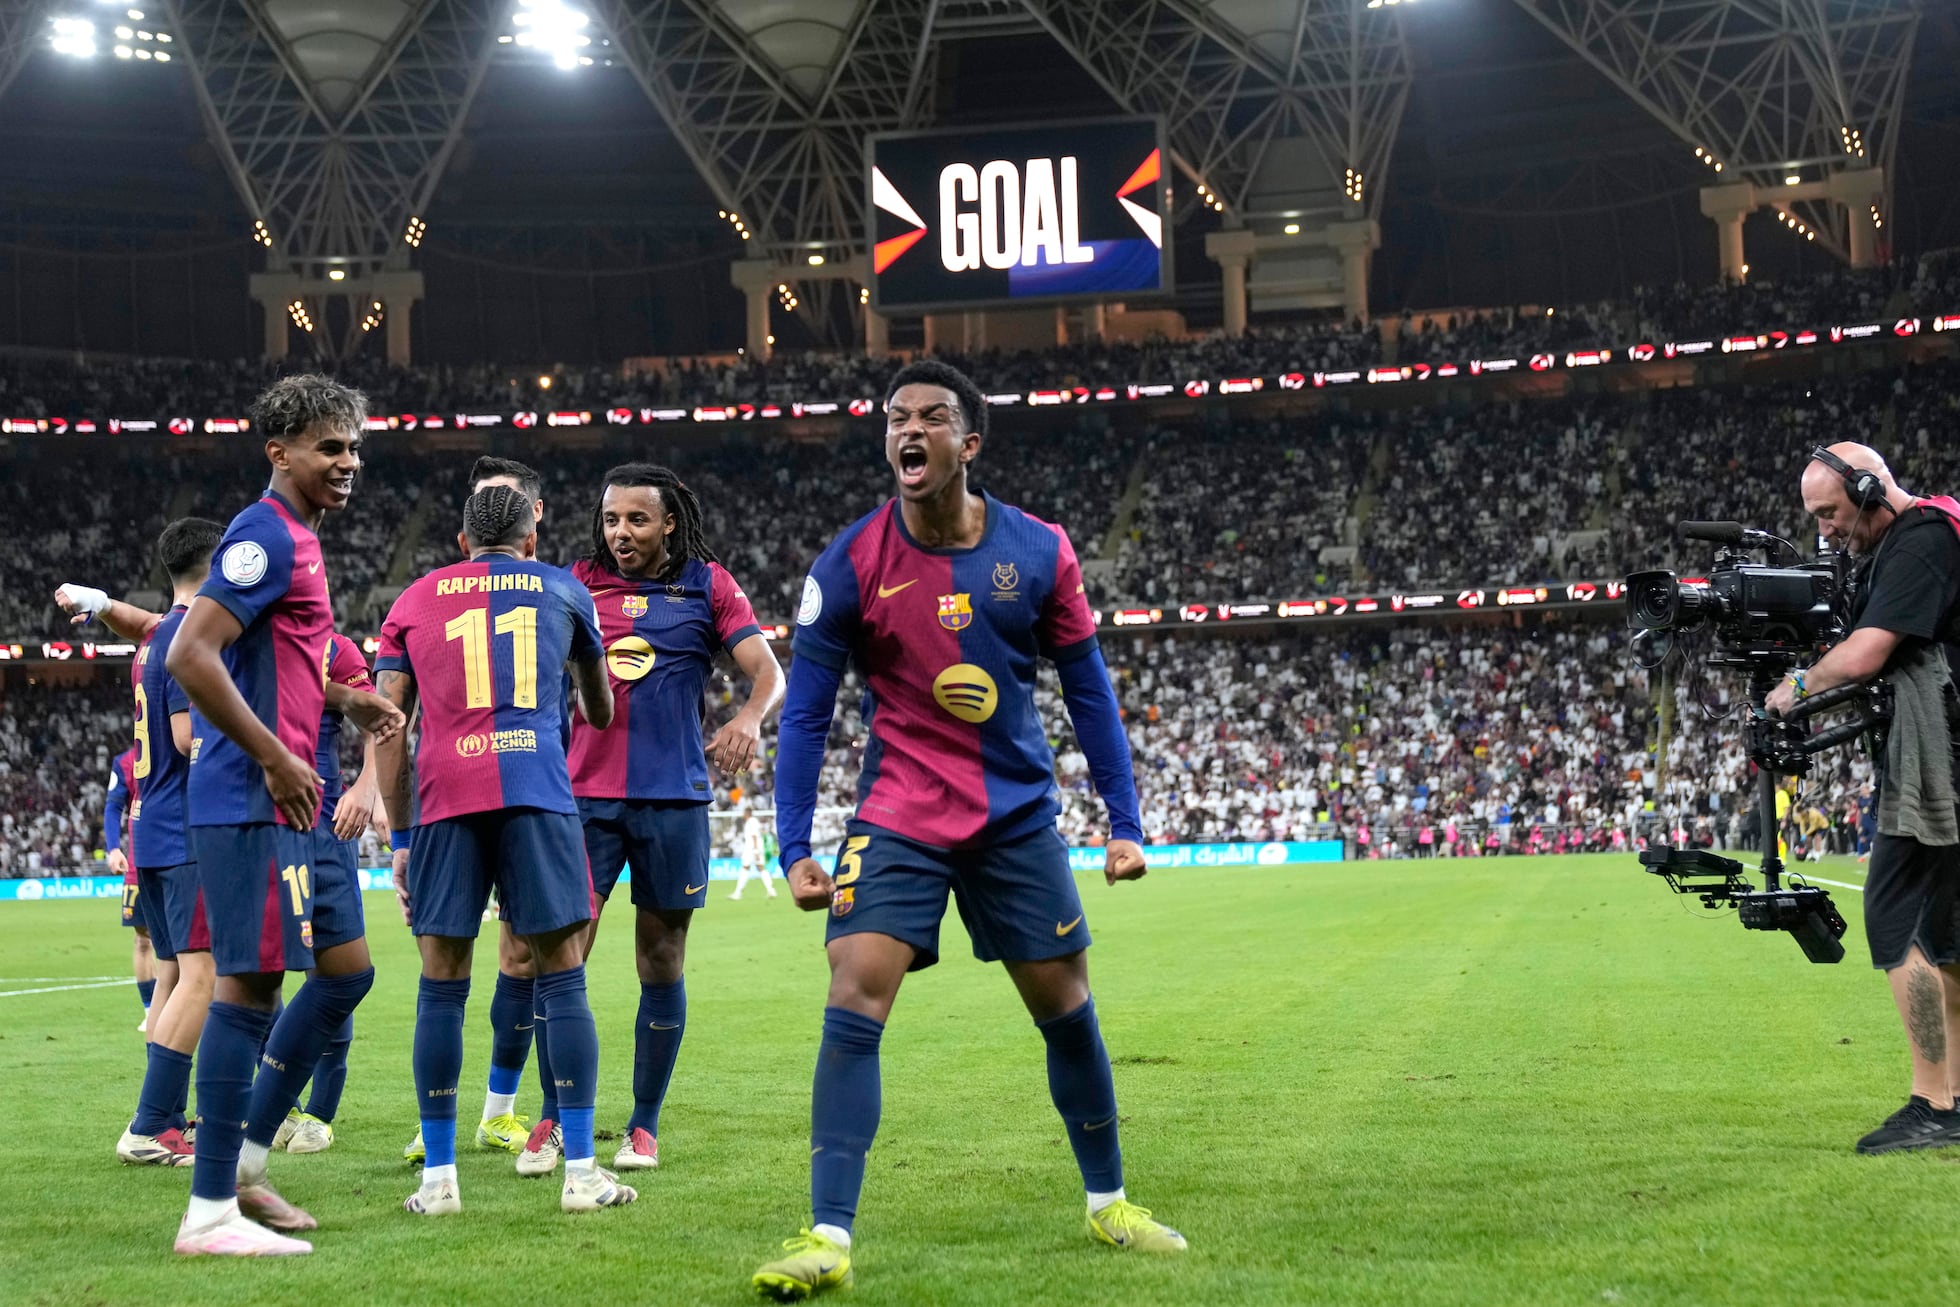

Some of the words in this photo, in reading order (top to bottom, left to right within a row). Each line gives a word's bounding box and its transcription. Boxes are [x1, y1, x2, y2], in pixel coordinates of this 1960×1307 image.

[939, 156, 1094, 272] GOAL
[436, 574, 544, 596] RAPHINHA
[445, 606, 538, 709] 11
[489, 729, 536, 741] UNHCR
[490, 738, 537, 749] ACNUR
[835, 836, 871, 886] 3
[122, 884, 139, 907] 17
